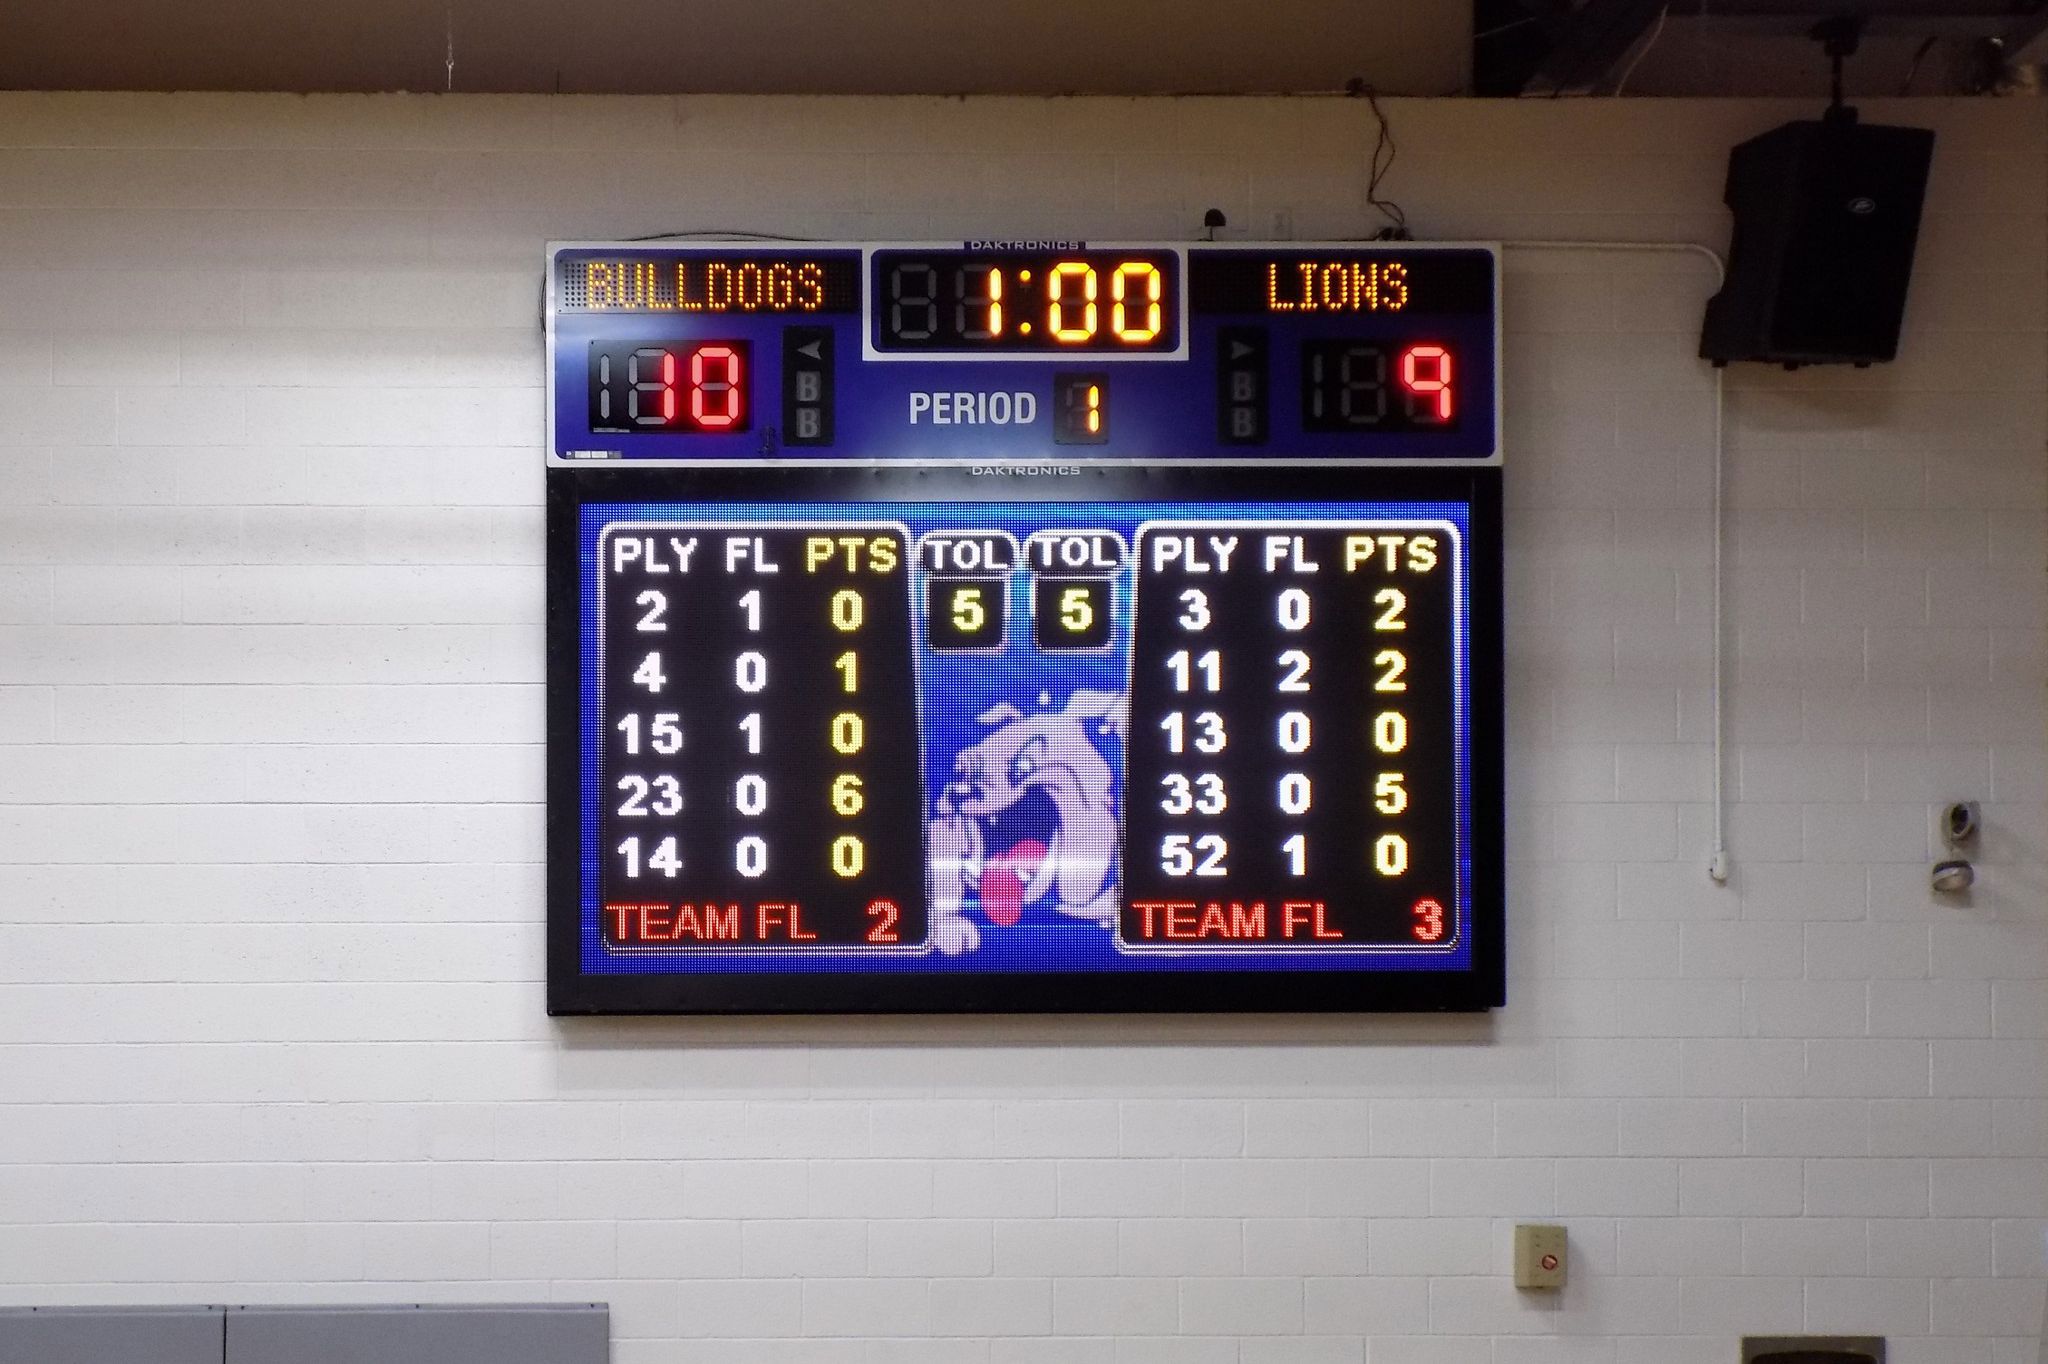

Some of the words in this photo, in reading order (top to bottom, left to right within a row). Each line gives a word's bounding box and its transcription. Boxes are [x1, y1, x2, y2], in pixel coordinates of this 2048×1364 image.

[970, 241, 1079, 250] DAKTRONICS
[587, 262, 822, 310] BULLDOGS
[989, 262, 1161, 342] 1:00
[1269, 263, 1408, 310] LIONS
[796, 371, 821, 400] B
[1403, 346, 1451, 420] 9
[796, 408, 821, 438] B
[910, 392, 1036, 425] PERIOD
[1088, 385, 1100, 433] 1
[971, 466, 1081, 476] DAKTRONICS
[614, 538, 698, 573] PLY
[726, 538, 778, 573] FL
[806, 538, 897, 573] PTS
[925, 539, 1007, 569] TOL
[1036, 537, 1116, 566] TOL
[1153, 537, 1238, 572] PLY
[1265, 537, 1318, 572] FL
[1345, 537, 1438, 572] PTS
[636, 590, 667, 631] 2
[739, 590, 761, 631] 1
[832, 590, 863, 631] 0
[952, 590, 983, 631] 5
[1061, 589, 1093, 630] 5
[1179, 589, 1211, 629] 3
[1279, 589, 1311, 629] 0
[1374, 589, 1406, 629] 2
[633, 652, 666, 692] 4
[735, 652, 767, 692] 0
[835, 652, 858, 692] 1
[1167, 650, 1221, 691] 11
[1279, 650, 1311, 691] 2
[1374, 650, 1406, 691] 2
[617, 713, 683, 754] 15
[739, 713, 761, 754] 1
[832, 713, 863, 754] 0
[1161, 712, 1227, 752] 13
[1279, 712, 1311, 752] 0
[1375, 712, 1407, 752] 0
[617, 775, 683, 816] 23
[735, 775, 767, 816] 0
[832, 775, 863, 816] 6
[1161, 773, 1227, 814] 33
[1279, 773, 1311, 814] 0
[1375, 773, 1407, 814] 5
[617, 837, 683, 877] 14
[735, 837, 767, 877] 0
[832, 837, 863, 877] 0
[1161, 835, 1227, 876] 52
[1283, 835, 1305, 876] 1
[1375, 835, 1408, 876] 0
[606, 904, 738, 940] TEAM
[757, 904, 816, 940] FL
[867, 901, 898, 942] 2
[1133, 902, 1266, 938] TEAM
[1284, 902, 1343, 938] FL
[1412, 900, 1443, 941] 3
